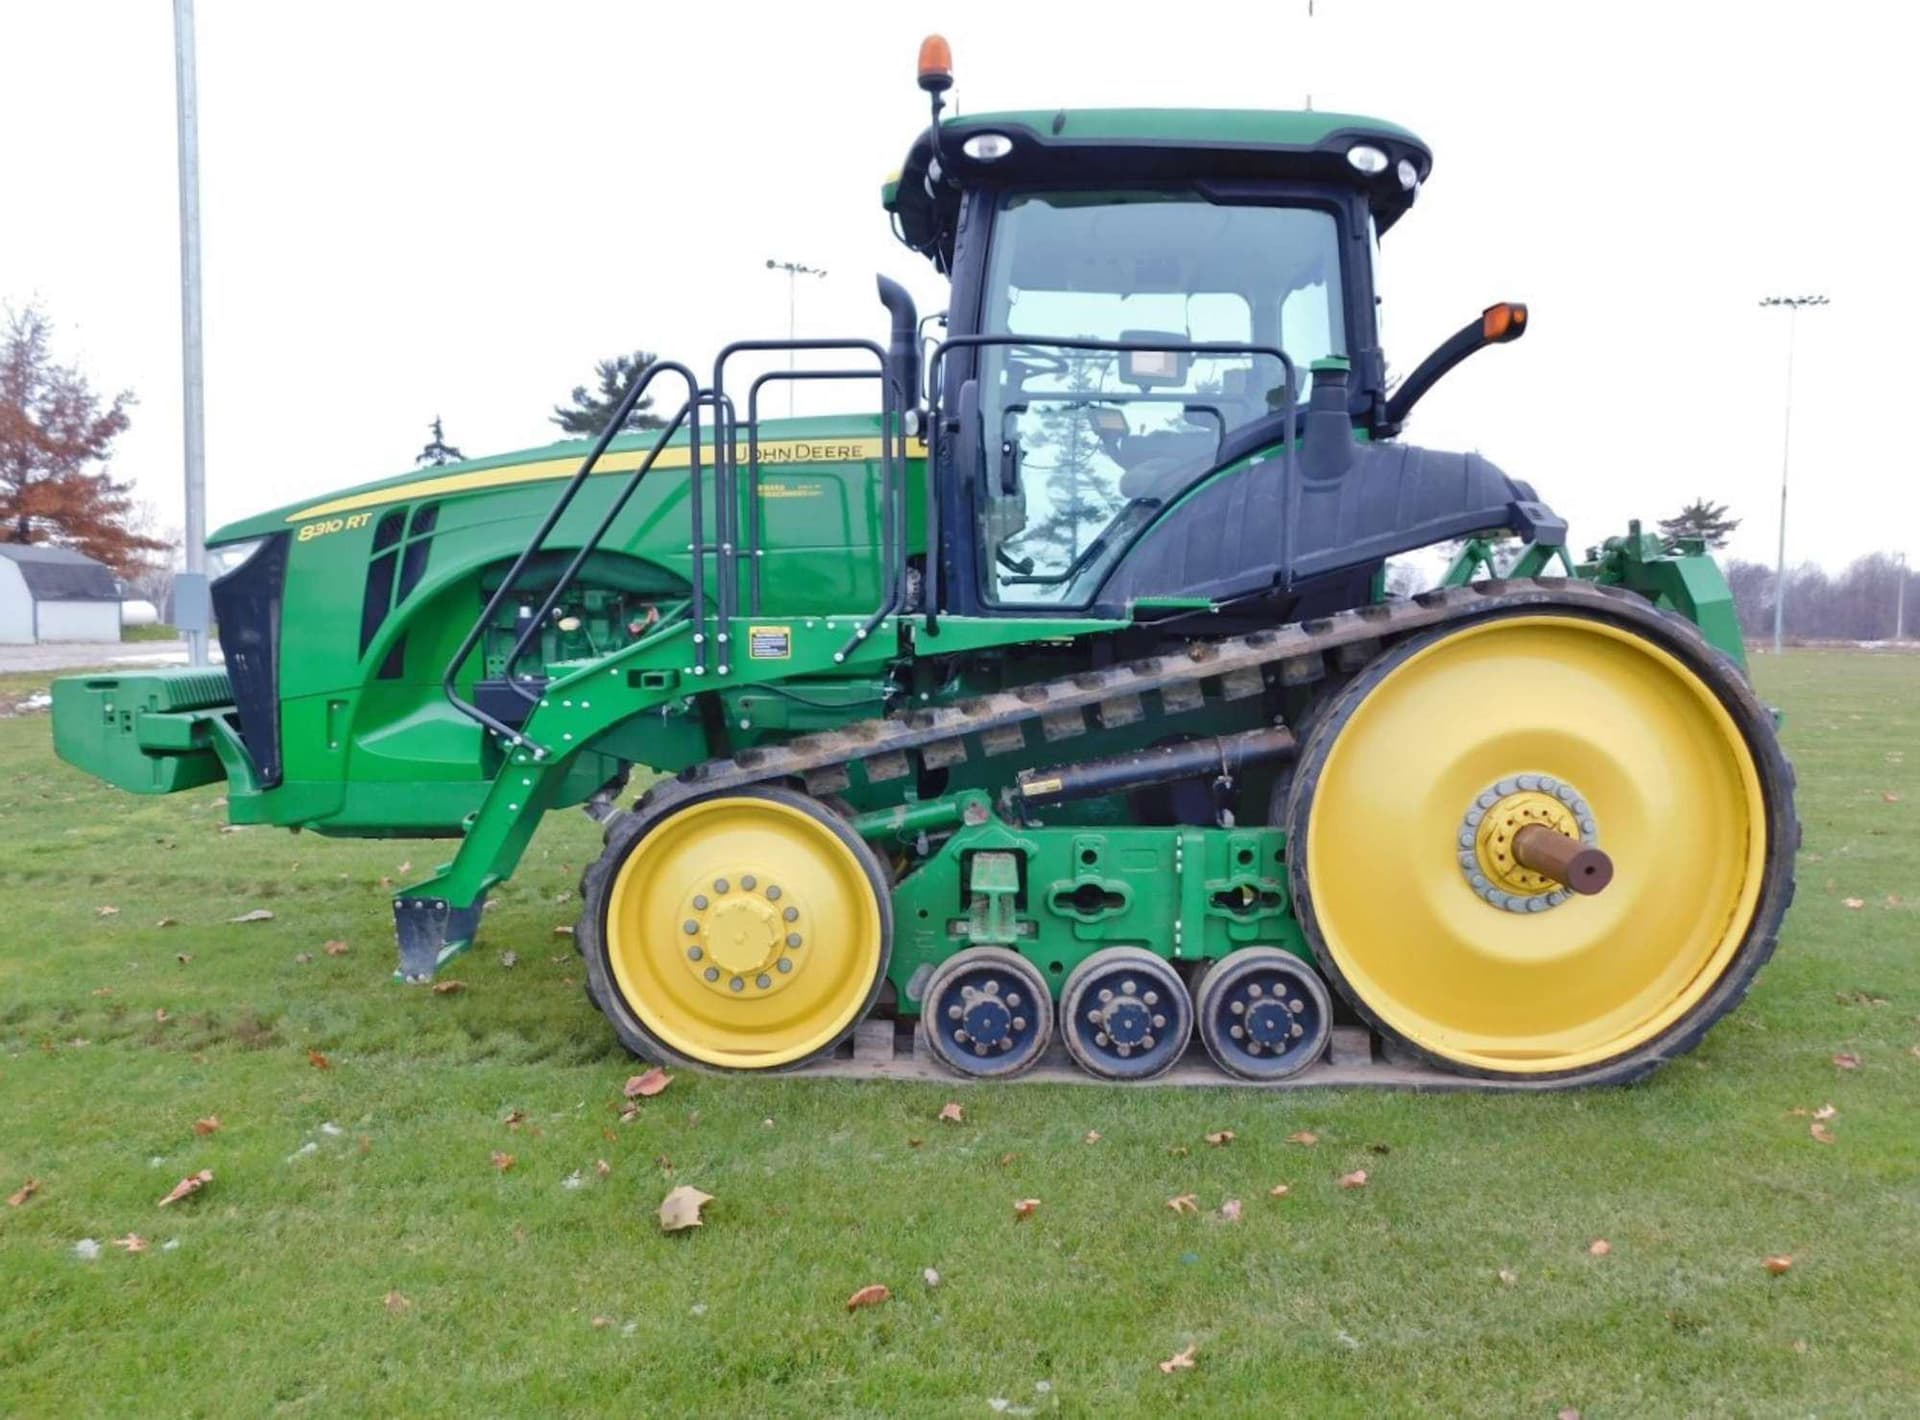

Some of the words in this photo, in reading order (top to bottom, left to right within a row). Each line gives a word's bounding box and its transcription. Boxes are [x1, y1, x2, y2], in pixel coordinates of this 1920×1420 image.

[795, 443, 863, 460] DEERE
[298, 519, 343, 542] 8310
[346, 512, 373, 530] RT
